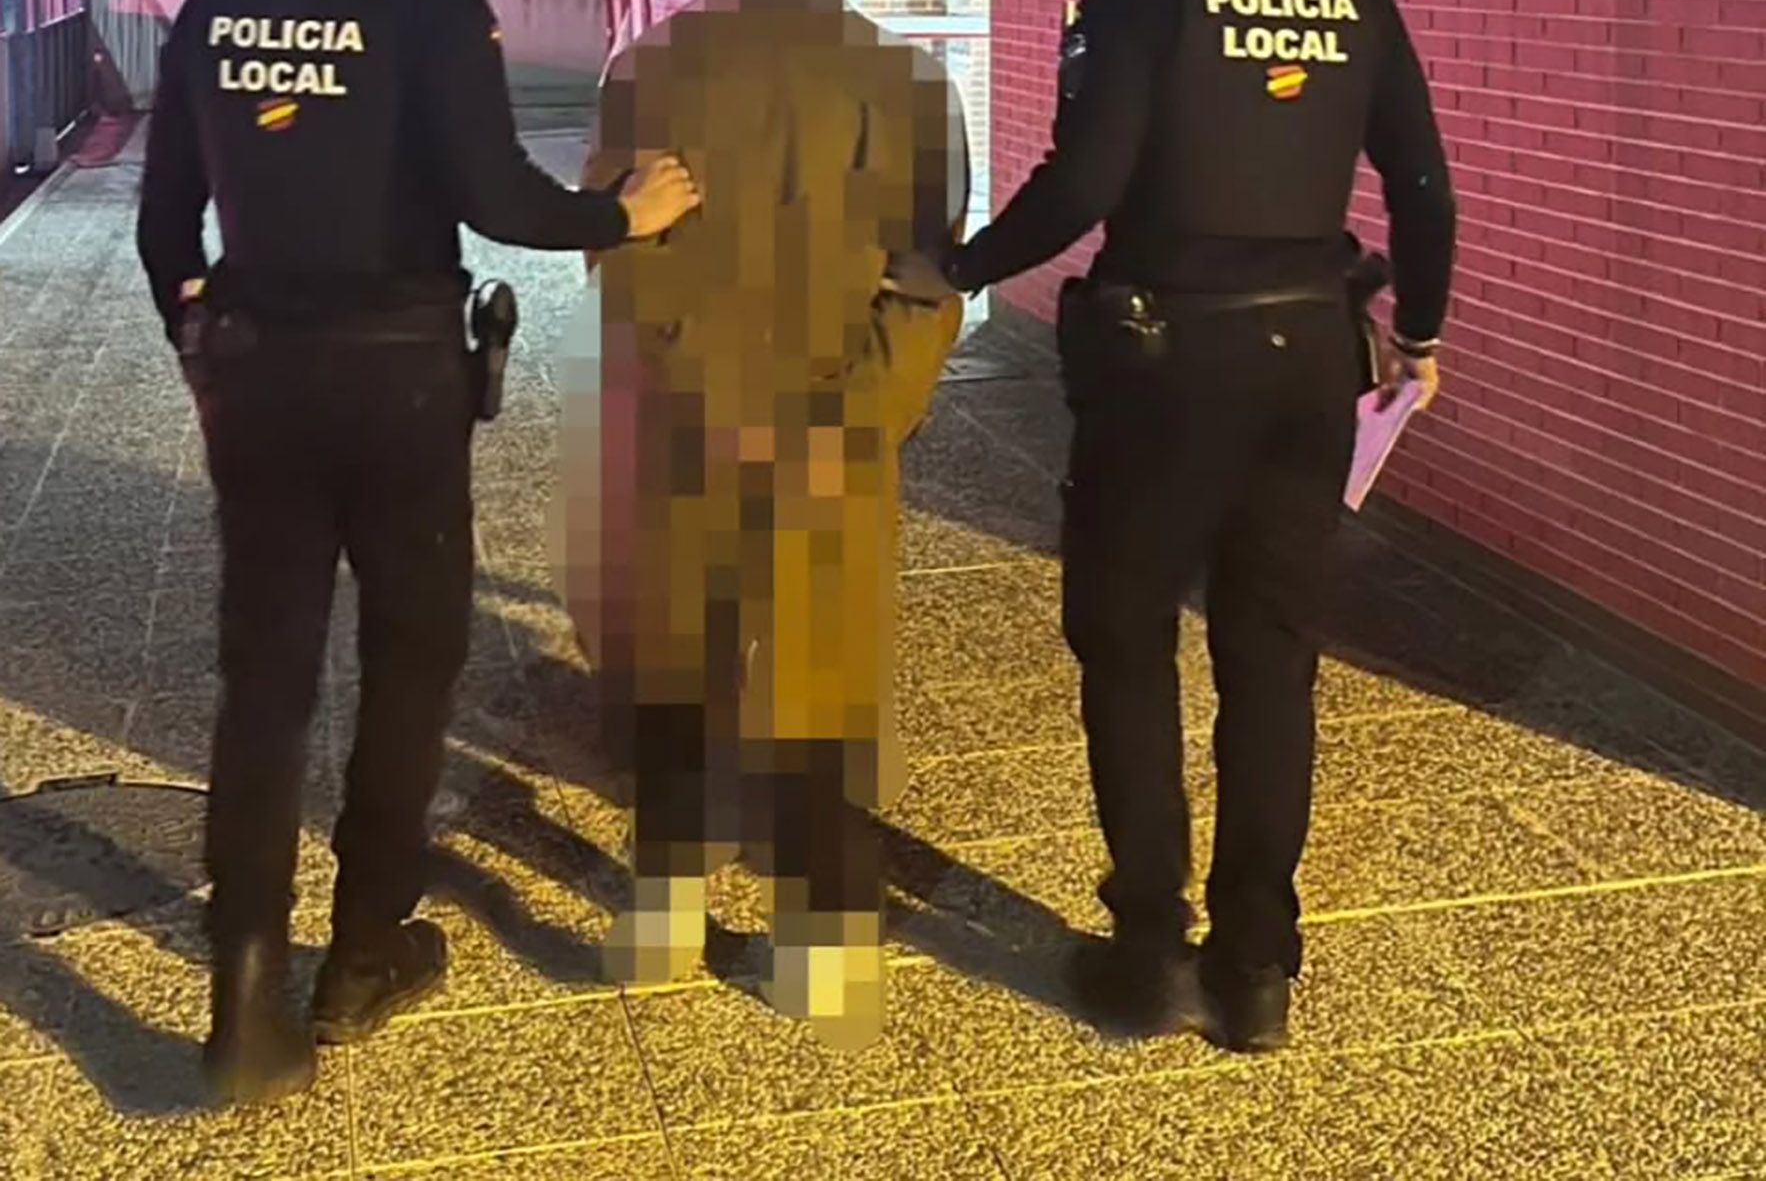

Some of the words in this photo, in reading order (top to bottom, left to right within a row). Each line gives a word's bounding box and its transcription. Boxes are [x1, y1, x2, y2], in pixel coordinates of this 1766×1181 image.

[208, 16, 364, 51] POLICIA
[1223, 26, 1348, 62] LOCAL
[218, 59, 347, 95] LOCAL
